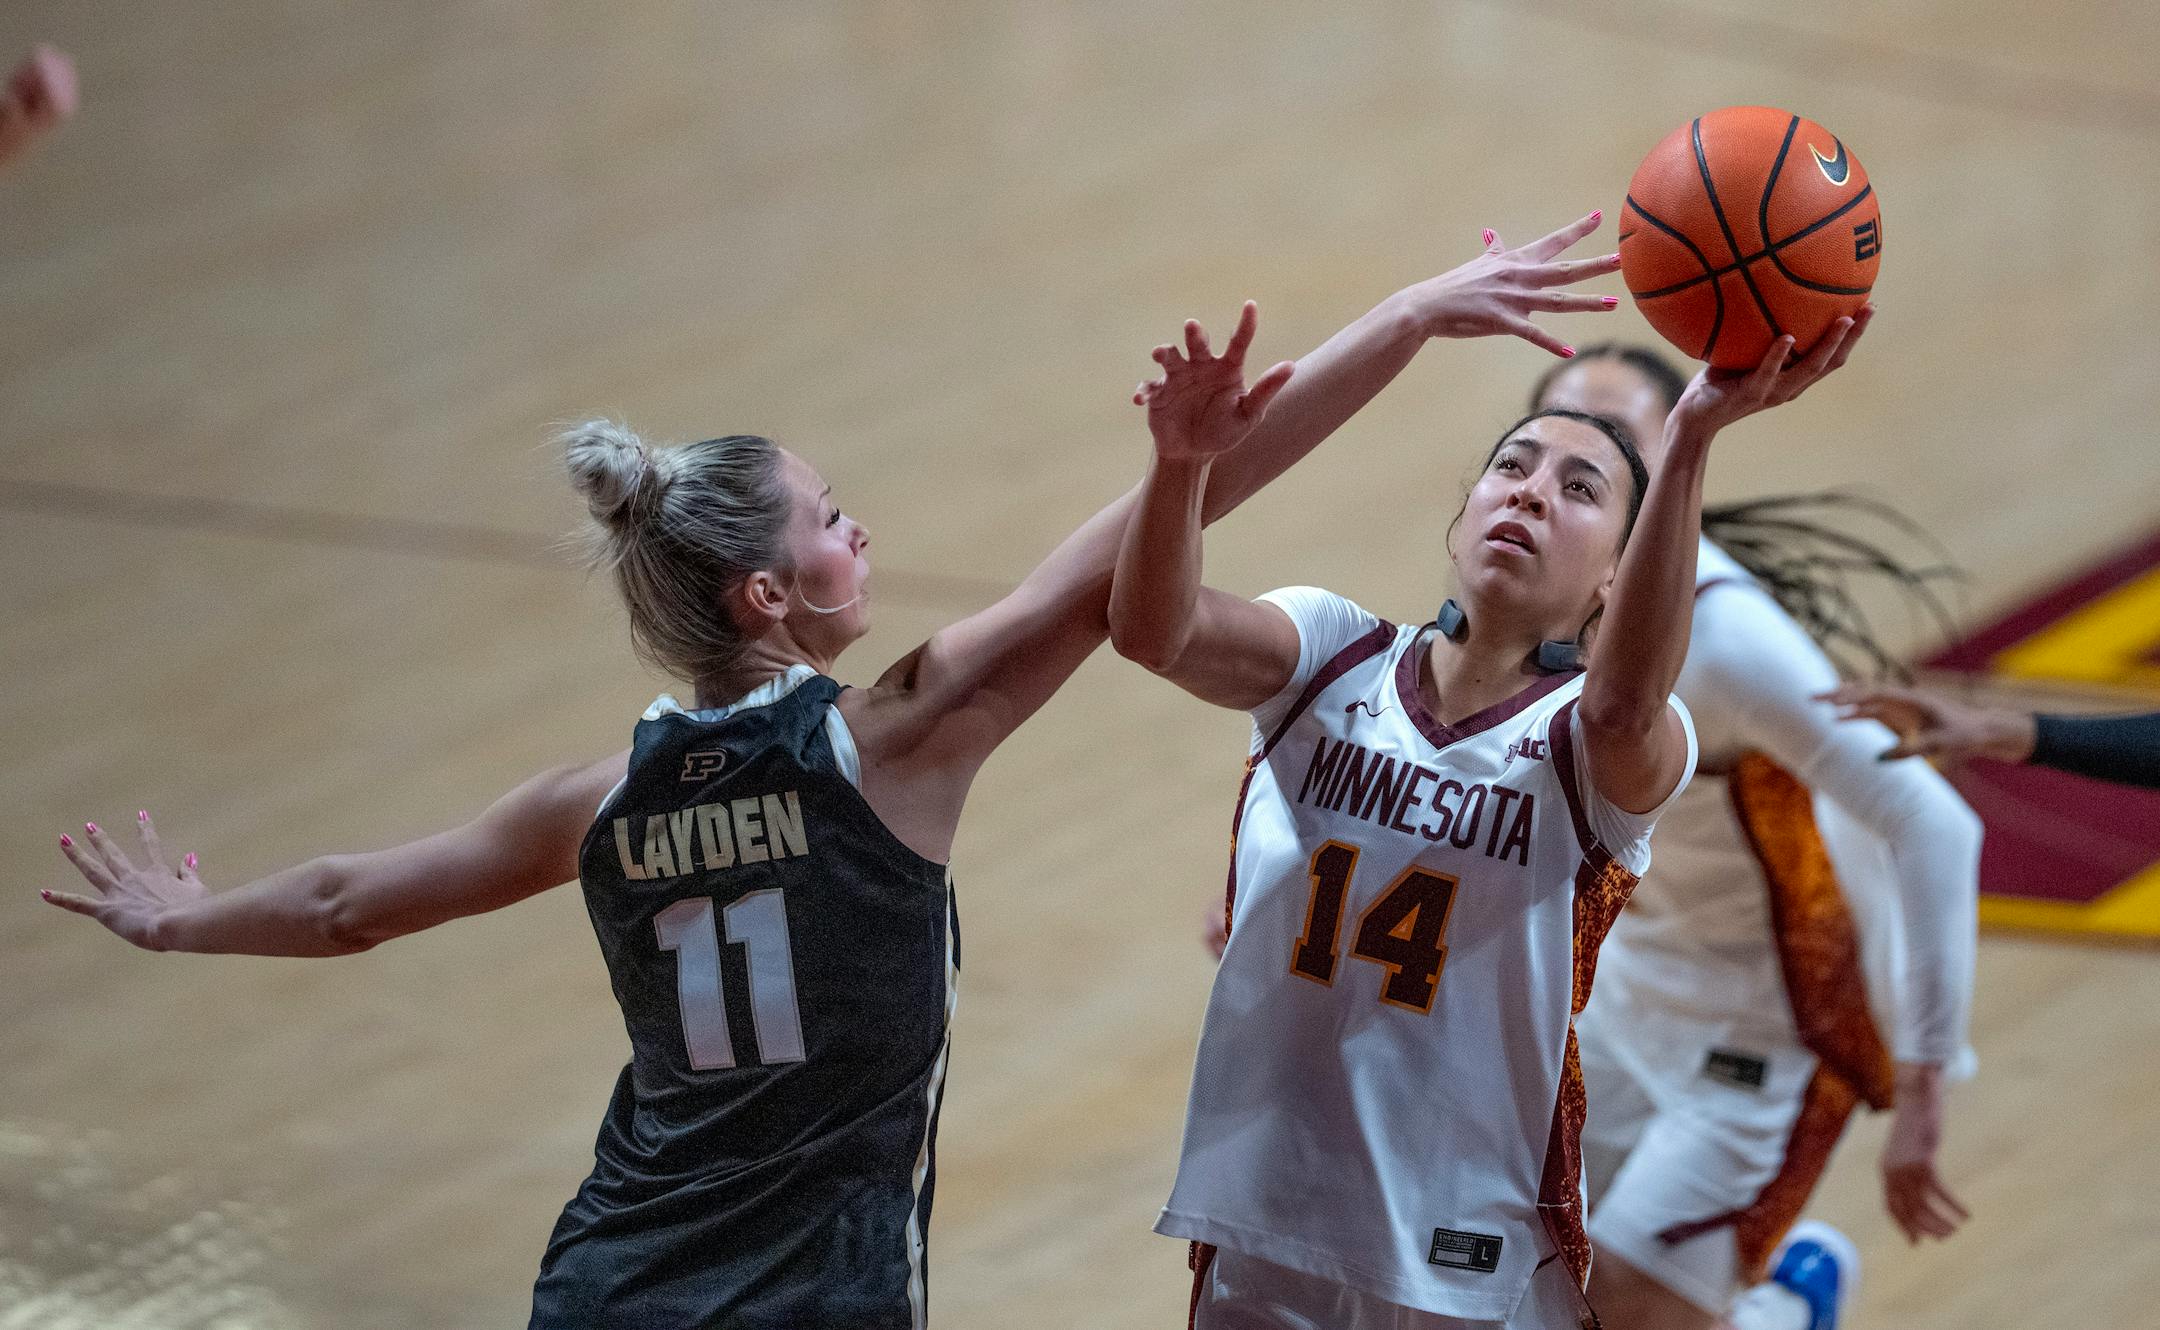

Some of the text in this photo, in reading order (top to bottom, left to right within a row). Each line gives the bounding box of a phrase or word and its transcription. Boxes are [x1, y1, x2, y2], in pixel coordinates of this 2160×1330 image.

[680, 747, 728, 781] P
[1297, 736, 1535, 867] MINNESOTA
[613, 790, 810, 881] LAYDEN
[653, 888, 806, 1070] 11
[1289, 838, 1461, 1016] 14
[1481, 1246, 1488, 1261] L
